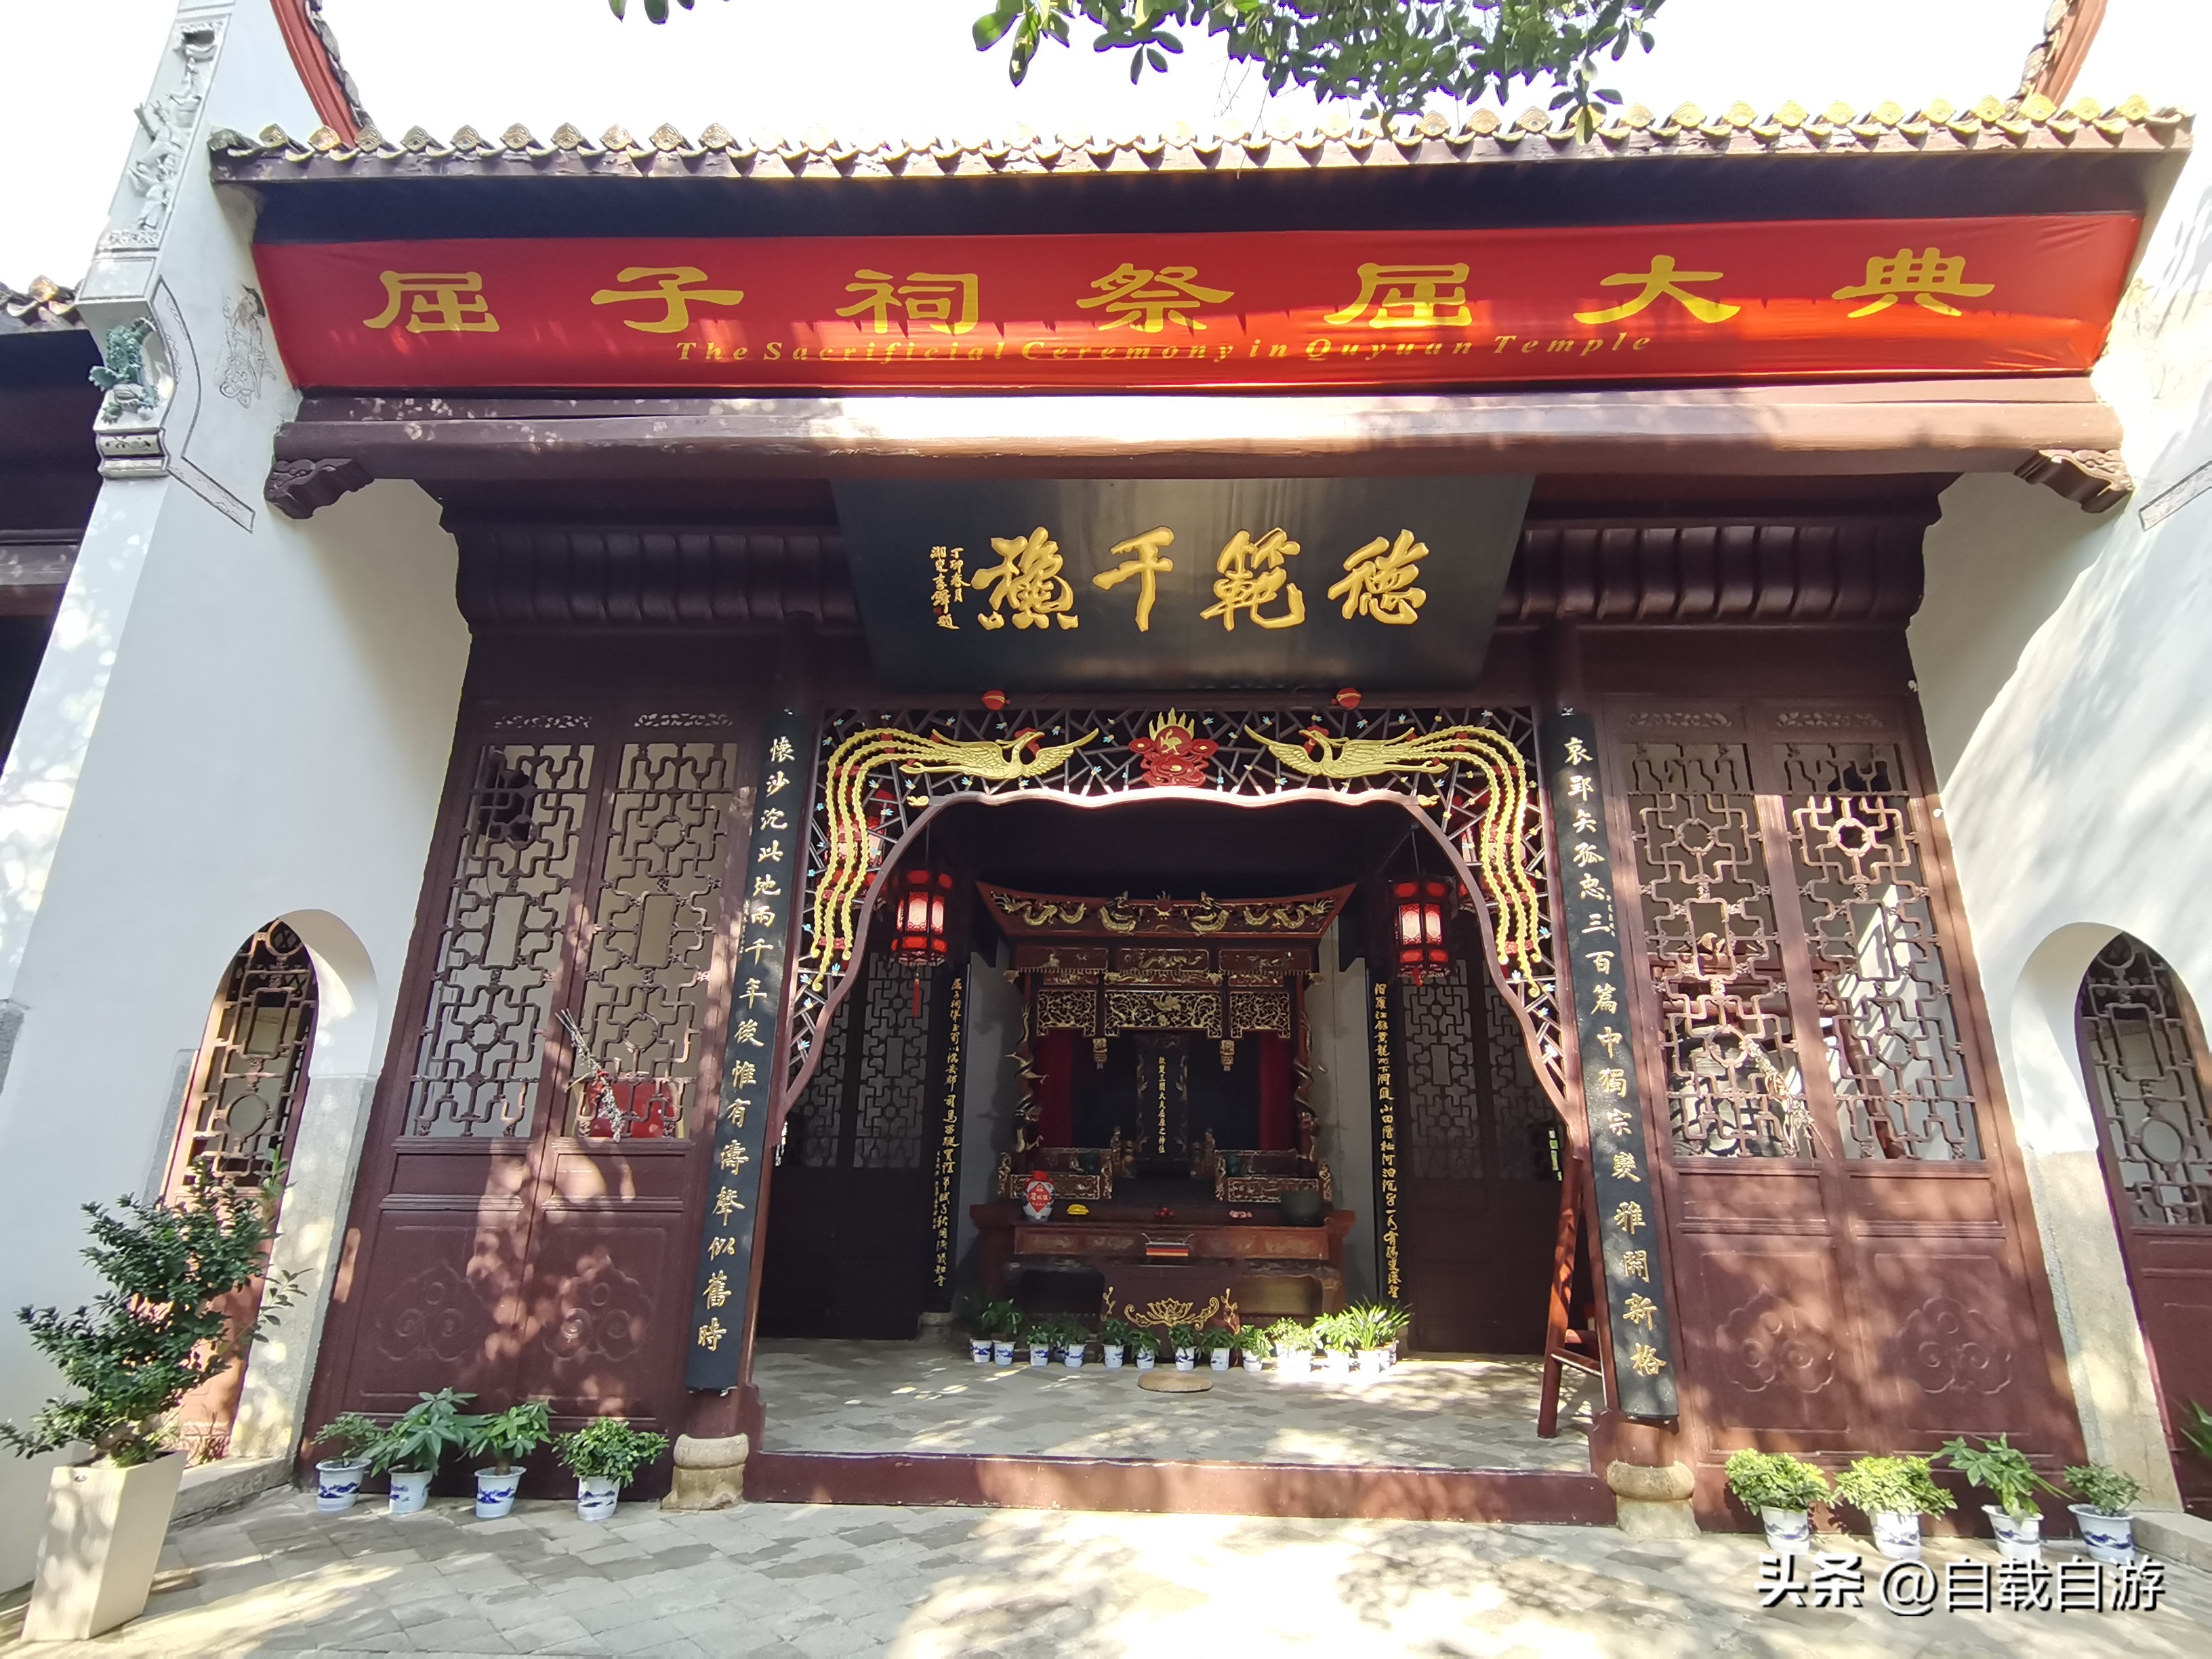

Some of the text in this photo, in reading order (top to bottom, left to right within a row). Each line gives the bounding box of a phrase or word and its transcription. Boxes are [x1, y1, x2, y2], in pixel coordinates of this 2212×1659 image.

[363, 247, 1995, 335] 屈子祠祭屈大典
[676, 333, 1651, 364] The Sacrificial Ceremony in Quyuan Temple
